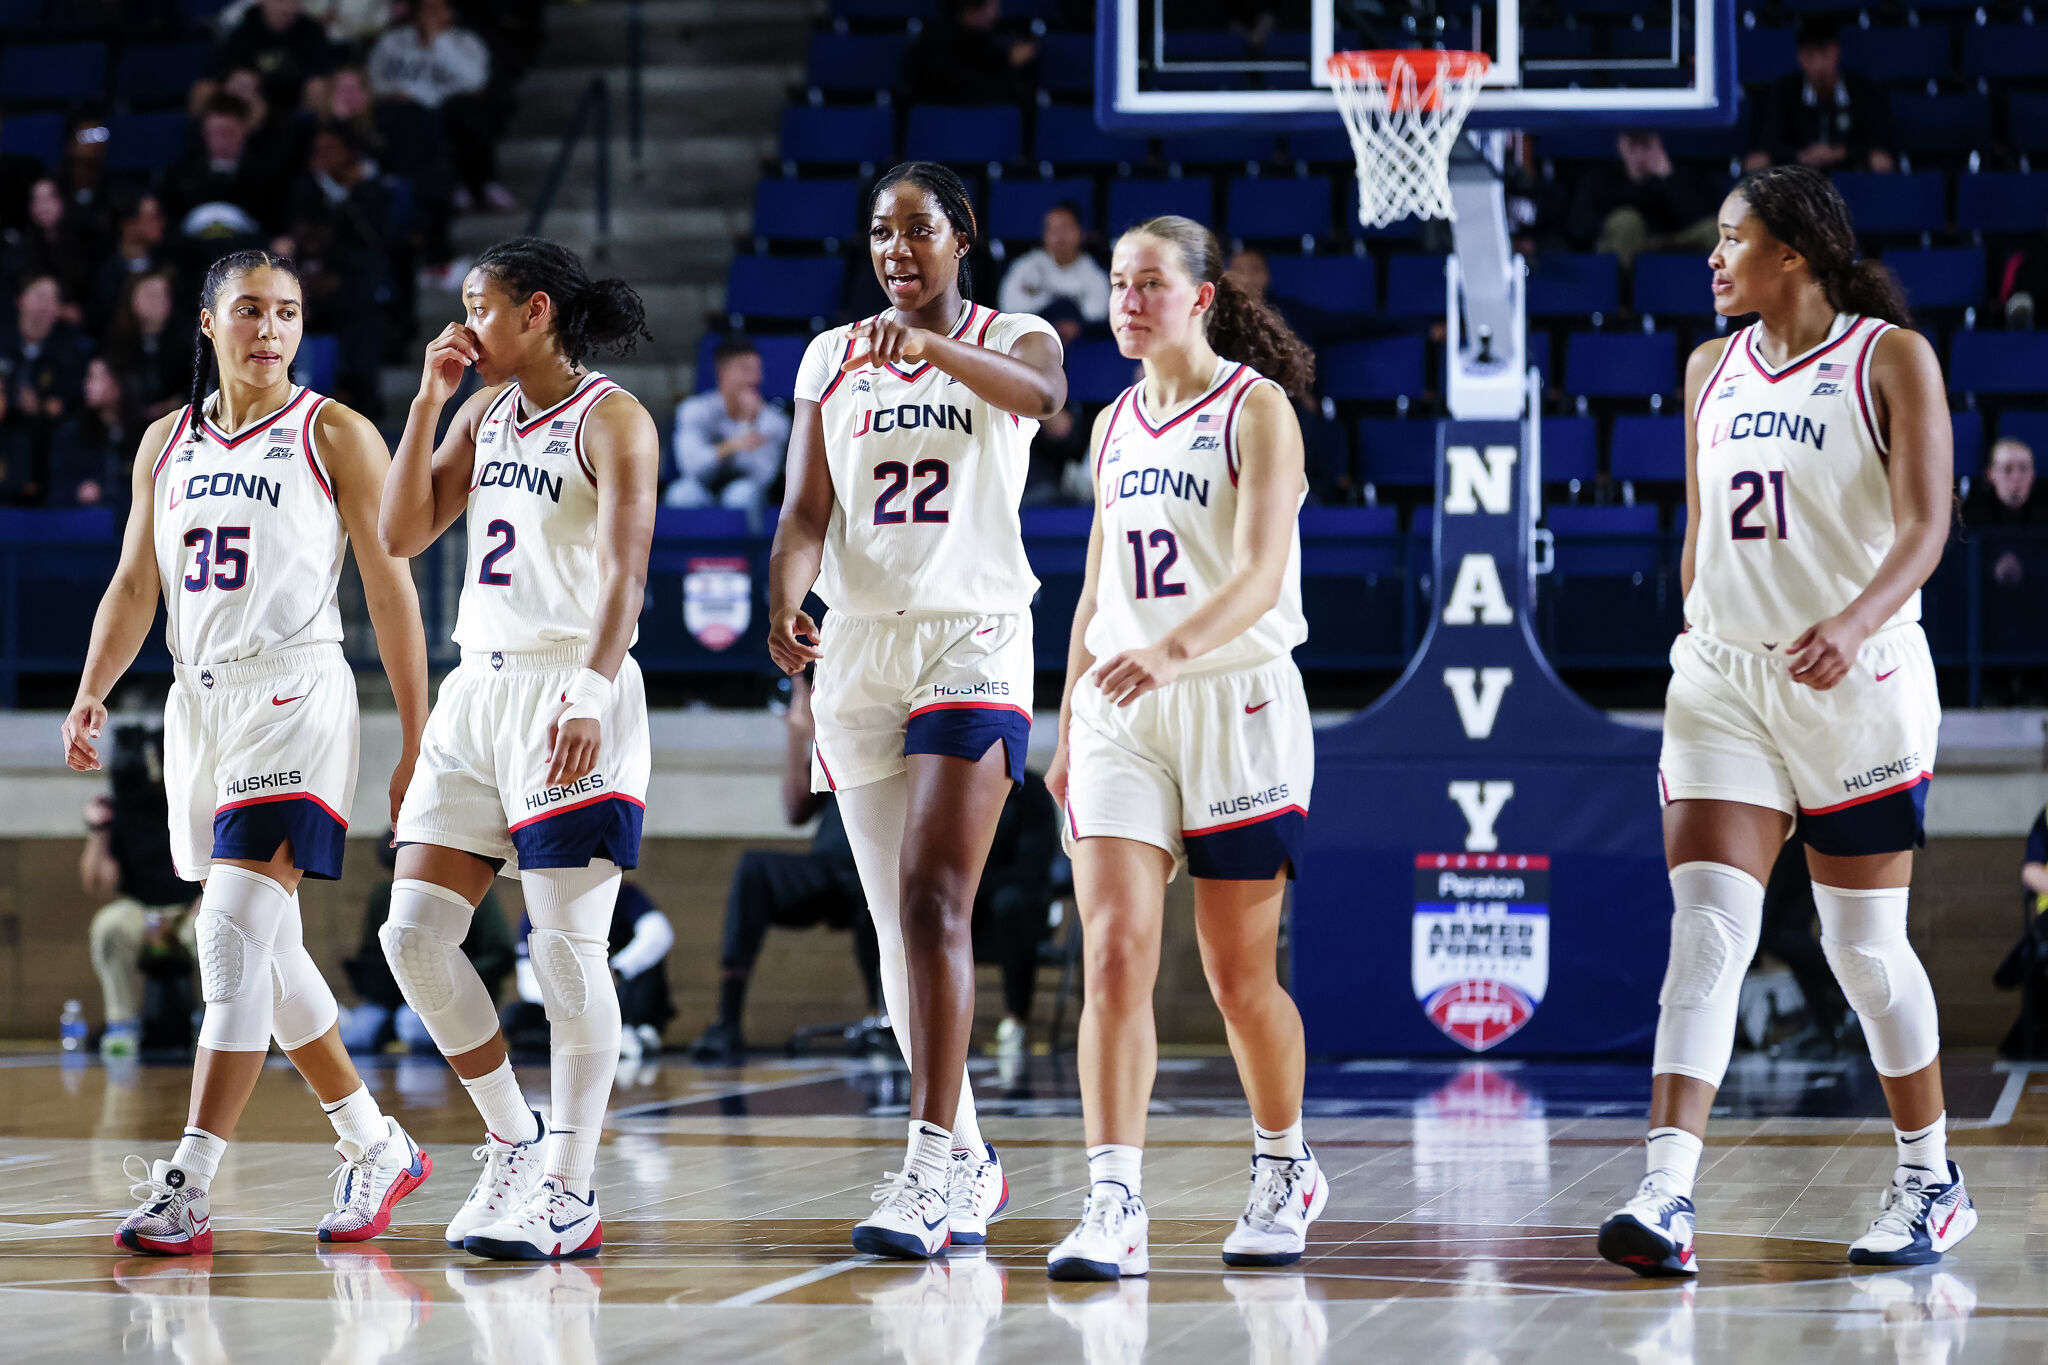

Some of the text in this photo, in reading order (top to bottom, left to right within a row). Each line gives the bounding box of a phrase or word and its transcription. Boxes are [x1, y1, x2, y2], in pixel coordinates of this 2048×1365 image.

[853, 404, 972, 438] UCONN
[1711, 411, 1825, 450] UCONN
[169, 472, 281, 510] UCONN
[873, 458, 949, 525] 22
[1105, 468, 1209, 507] UCONN
[1730, 470, 1788, 540] 21
[183, 526, 250, 592] 35
[479, 519, 516, 586] 2
[1127, 529, 1187, 599] 12
[1443, 446, 1517, 852] NAVY
[934, 682, 1009, 697] HUSKIES
[227, 770, 302, 796] HUSKIES
[526, 774, 604, 810] HUSKIES
[1209, 784, 1290, 817] HUSKIES
